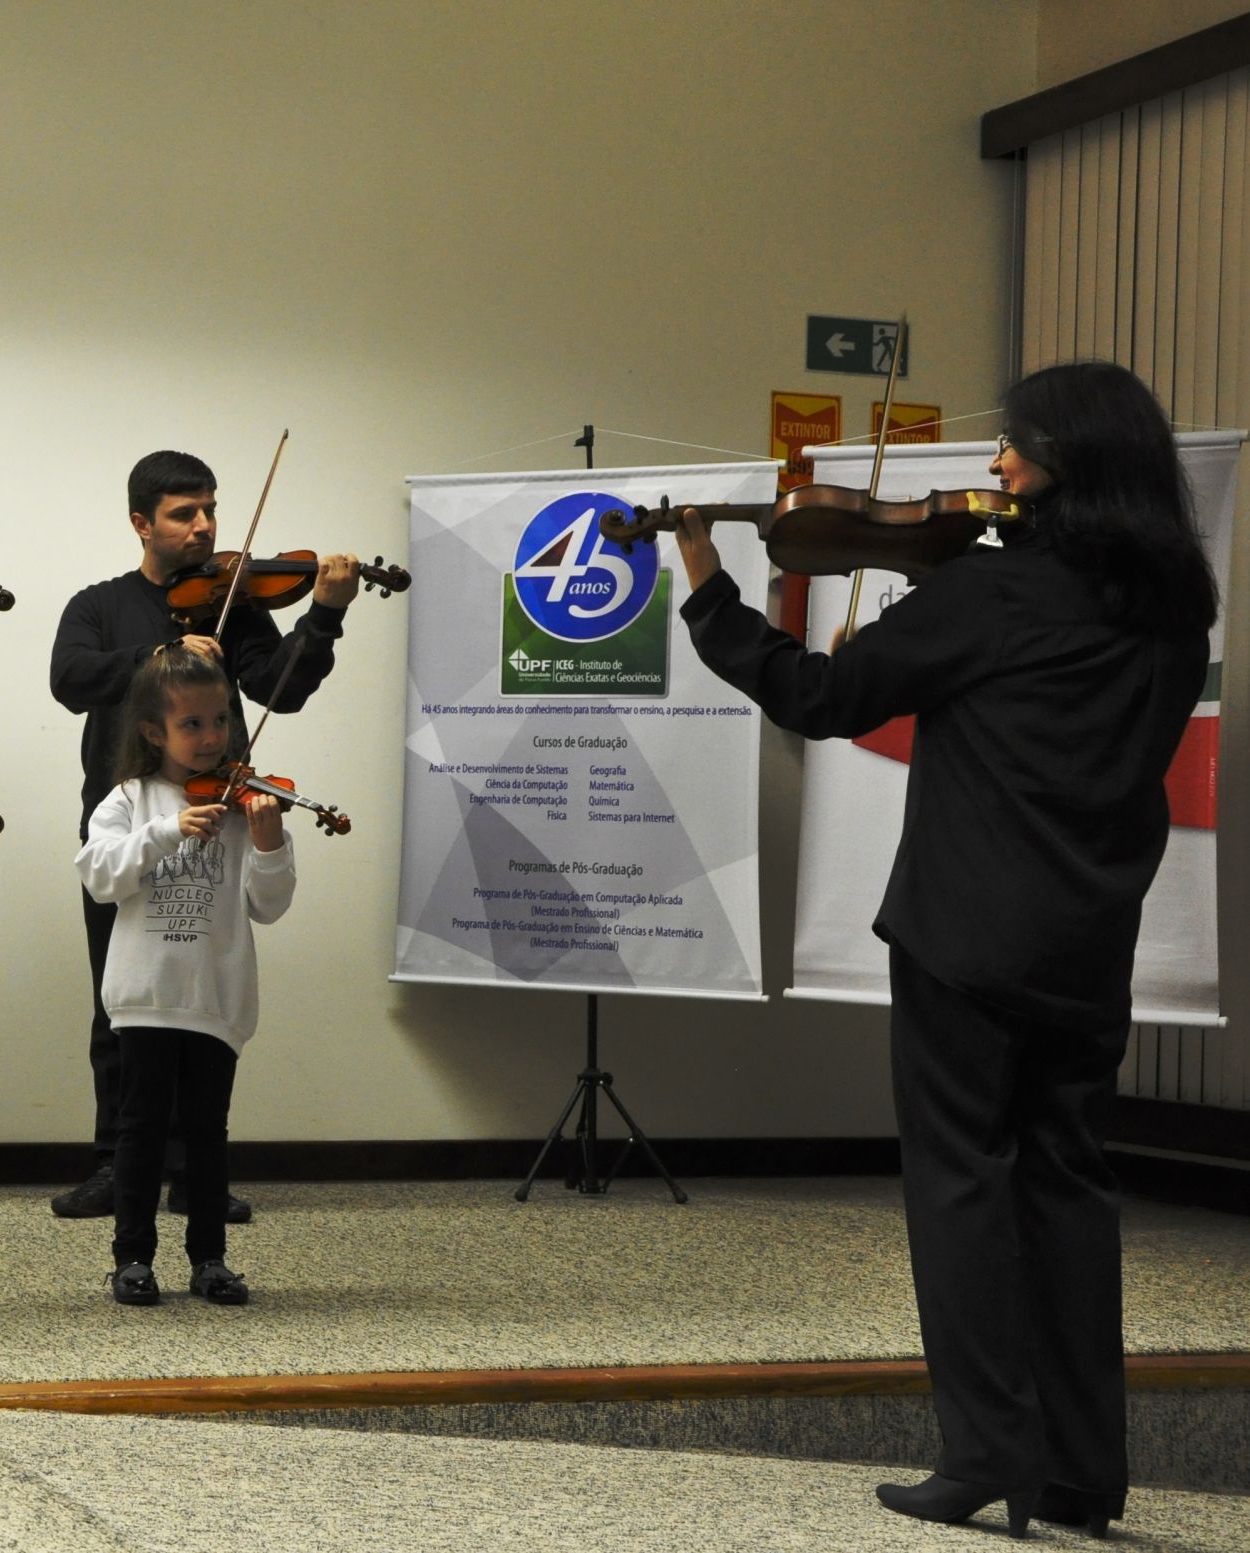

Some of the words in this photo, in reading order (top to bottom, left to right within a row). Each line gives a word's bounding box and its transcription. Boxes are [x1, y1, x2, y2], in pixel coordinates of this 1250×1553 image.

[781, 421, 831, 440] EXTINTOR
[515, 508, 634, 618] 45
[569, 580, 611, 595] anos
[518, 659, 552, 672] UPF
[555, 659, 574, 670] ICEG
[580, 659, 612, 670] Instituto
[613, 659, 623, 670] de
[555, 672, 585, 683] Ciências
[586, 672, 610, 683] Exatas
[610, 675, 616, 683] e
[616, 672, 662, 683] Geociências
[421, 704, 432, 714] Há
[432, 704, 441, 714] 45
[441, 706, 458, 714] anos
[459, 704, 495, 717] integrando
[495, 704, 513, 715] áreas
[514, 704, 524, 715] do
[524, 704, 573, 715] conhecimento
[573, 706, 589, 717] para
[590, 704, 633, 715] transformar
[639, 705, 665, 717] ensino,
[672, 705, 705, 718] pesquisa
[533, 735, 563, 748] Cursos
[564, 735, 576, 748] de
[577, 735, 628, 751] Graduação
[429, 762, 455, 773] Análise
[462, 763, 524, 775] Desenvolvimento
[525, 764, 535, 775] de
[535, 764, 569, 775] Sistemas
[589, 765, 627, 778] Geografia
[485, 778, 510, 789] Ciência
[511, 779, 521, 789] da
[522, 779, 568, 792] Computação
[589, 780, 635, 792] Matemática
[469, 793, 510, 807] Engenharia
[511, 794, 521, 804] de
[522, 794, 568, 807] Computação
[588, 810, 622, 822] Sistemas
[623, 813, 641, 825] para
[642, 812, 675, 824] Internet
[508, 860, 557, 876] Programas
[558, 861, 570, 874] de
[572, 862, 643, 878] Pós-Graduação
[473, 887, 510, 901] Programa
[511, 888, 522, 900] de
[523, 889, 580, 904] Pós-Graduação
[580, 893, 594, 903] em
[595, 891, 647, 907] Computação
[647, 893, 684, 906] Aplicada
[157, 904, 208, 916] SUZUKI
[531, 905, 570, 918] (Mestrado
[571, 906, 620, 920] Profissional)
[167, 919, 197, 930] UPF
[452, 918, 490, 932] Programa
[491, 919, 501, 930] de
[502, 919, 559, 935] Pós-Graduação
[560, 923, 573, 933] em
[574, 923, 600, 935] Ensino
[601, 924, 612, 936] de
[613, 924, 647, 937] Ciências
[648, 928, 654, 937] e
[655, 926, 704, 939] Matemática
[530, 937, 569, 950] (Mestrado
[570, 938, 619, 952] Profissional)
